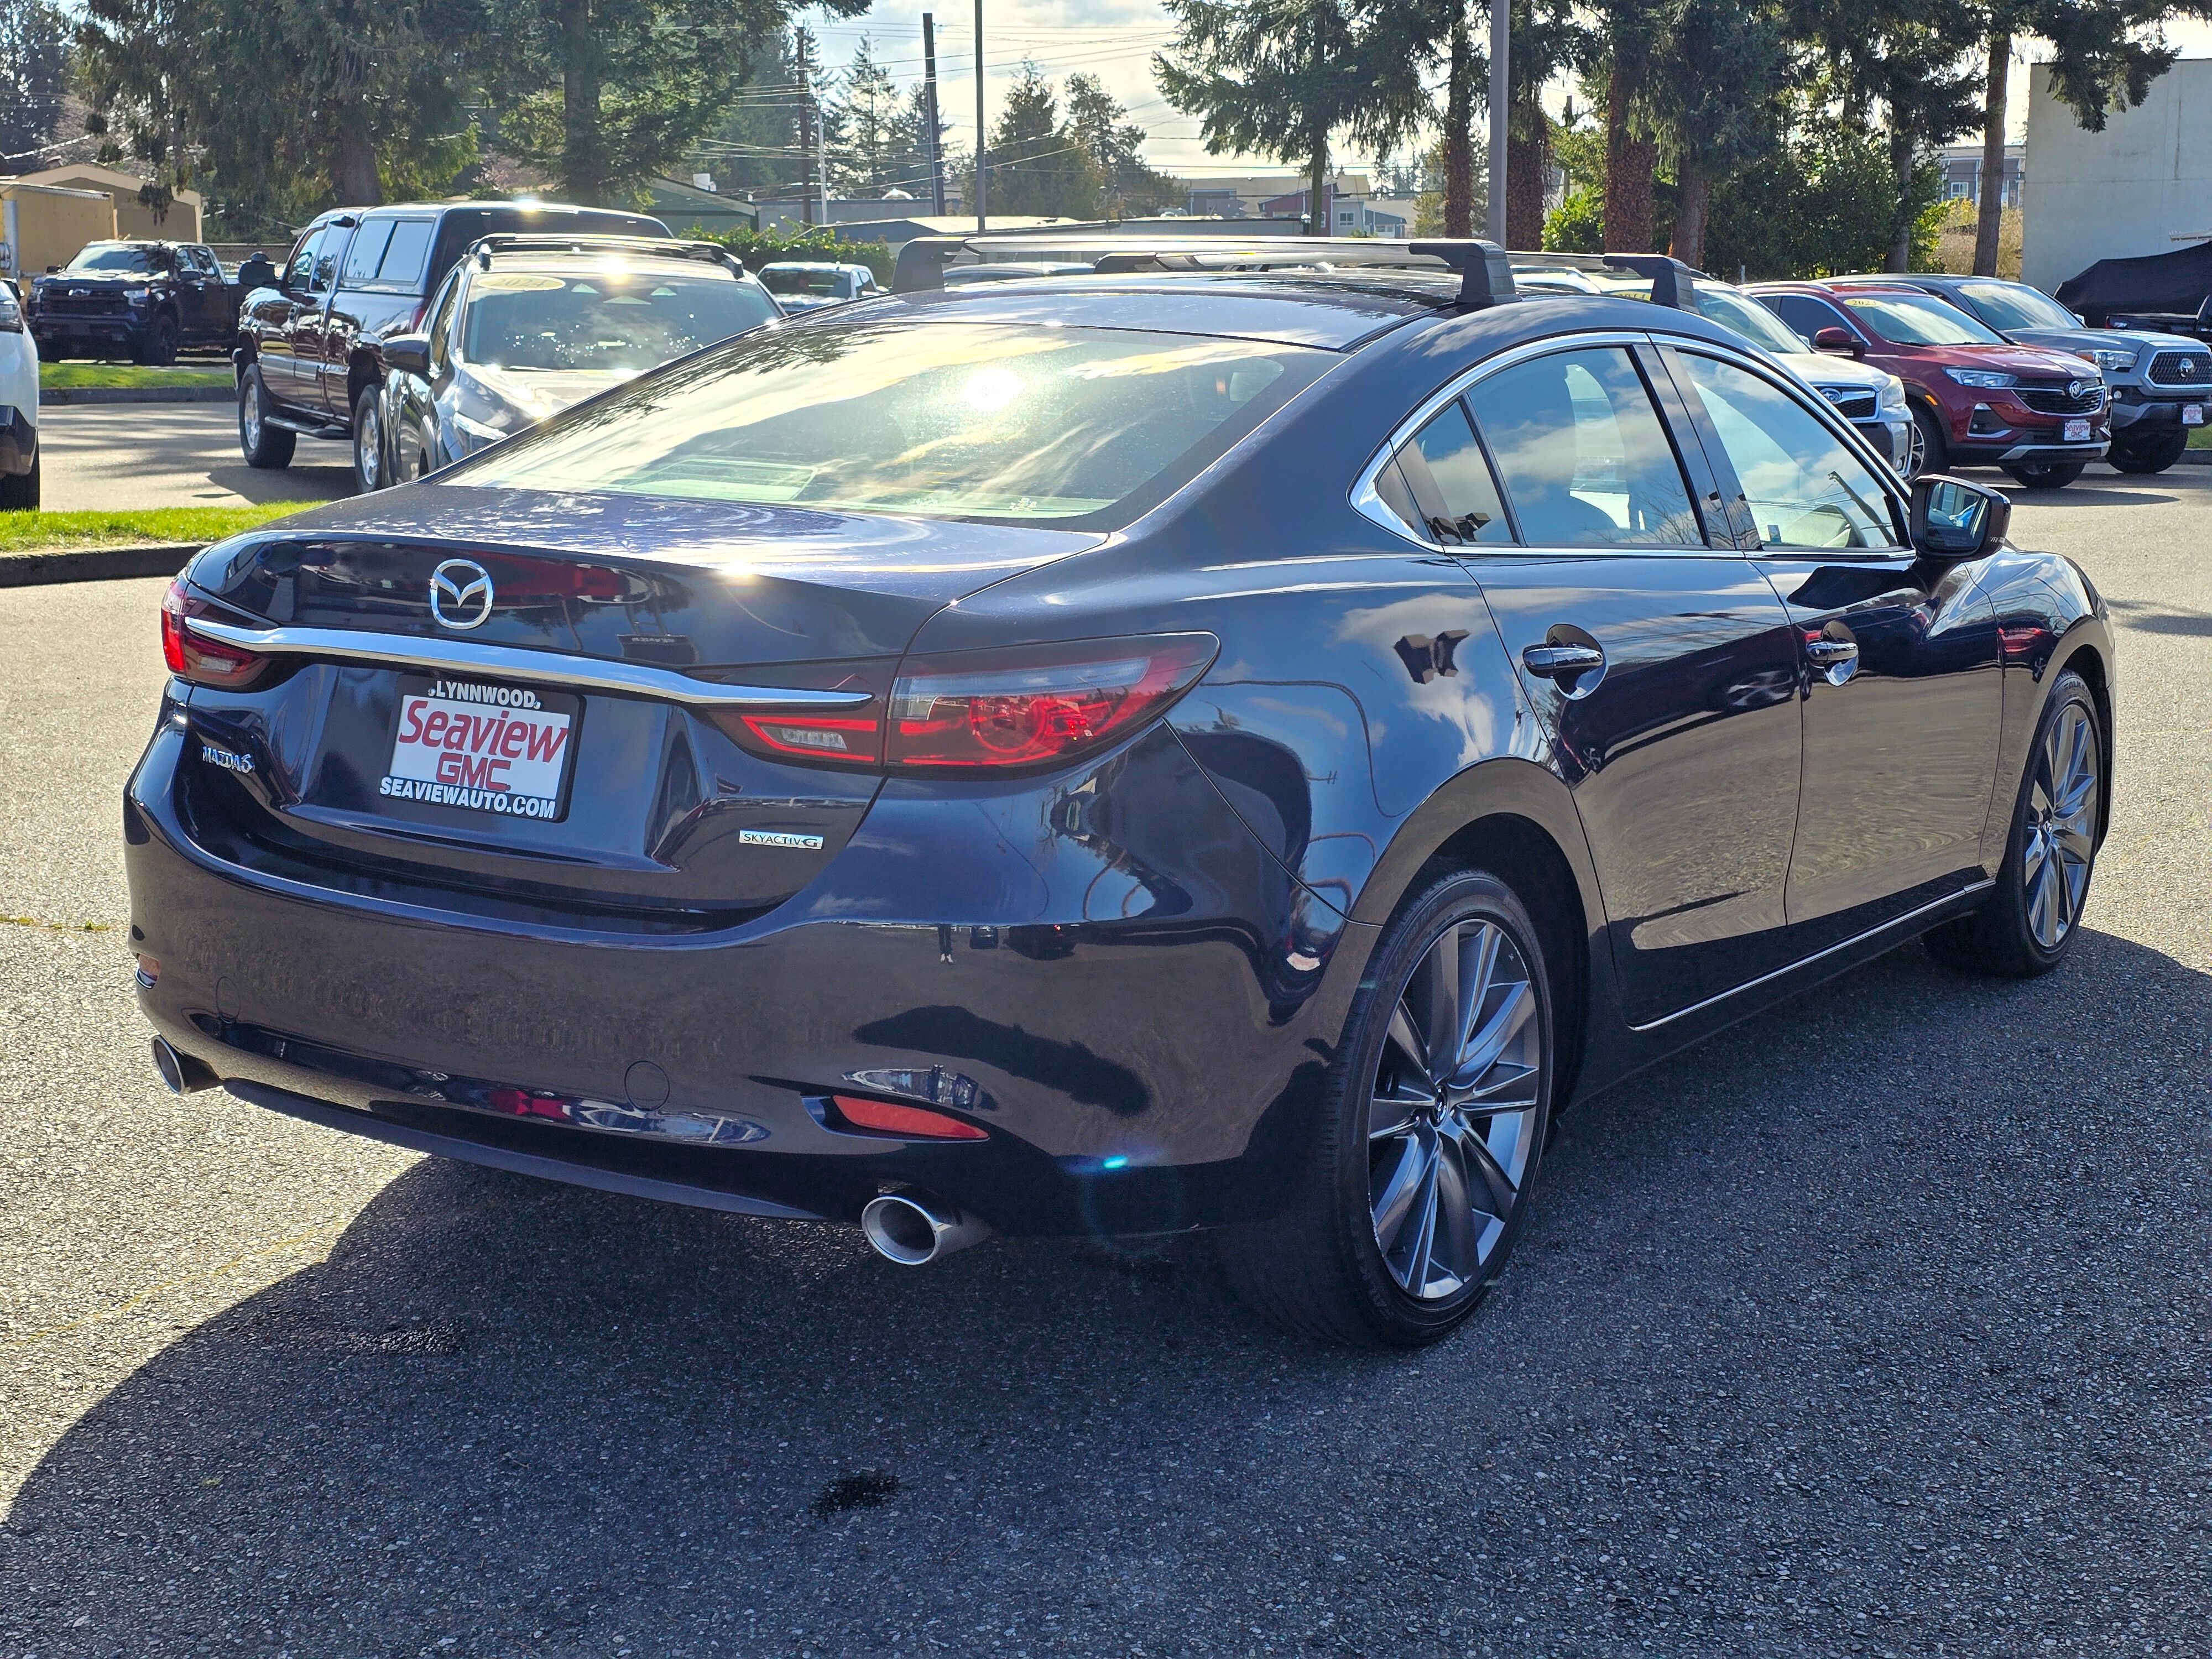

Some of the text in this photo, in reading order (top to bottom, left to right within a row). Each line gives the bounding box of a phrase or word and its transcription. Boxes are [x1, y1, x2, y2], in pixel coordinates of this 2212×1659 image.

[436, 680, 536, 708] LYNNWOOD
[398, 699, 568, 763] Seaview
[436, 752, 512, 792] GMC
[379, 776, 556, 819] SEAVIEWAUTO.COM
